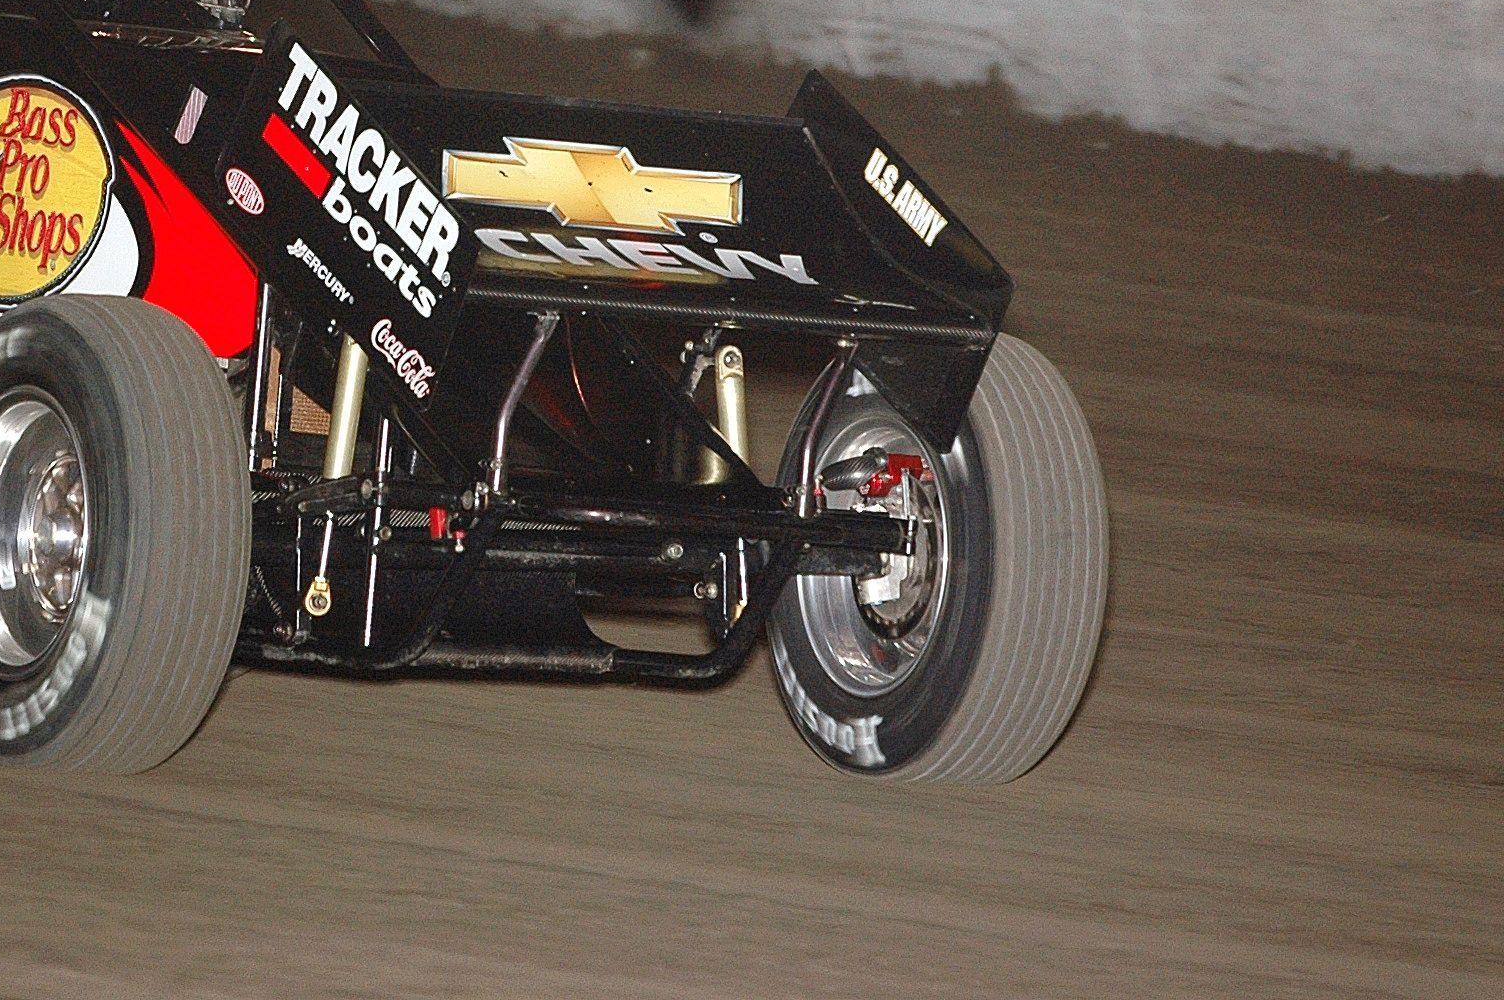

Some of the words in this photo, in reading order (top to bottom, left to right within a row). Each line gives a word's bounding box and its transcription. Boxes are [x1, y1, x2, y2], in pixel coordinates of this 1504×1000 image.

[277, 43, 459, 281] TRACKER
[864, 148, 899, 206] U.S.
[891, 179, 949, 247] ARMY
[288, 238, 350, 303] MERCURY
[325, 175, 438, 318] boats
[472, 226, 819, 286] CHEVY
